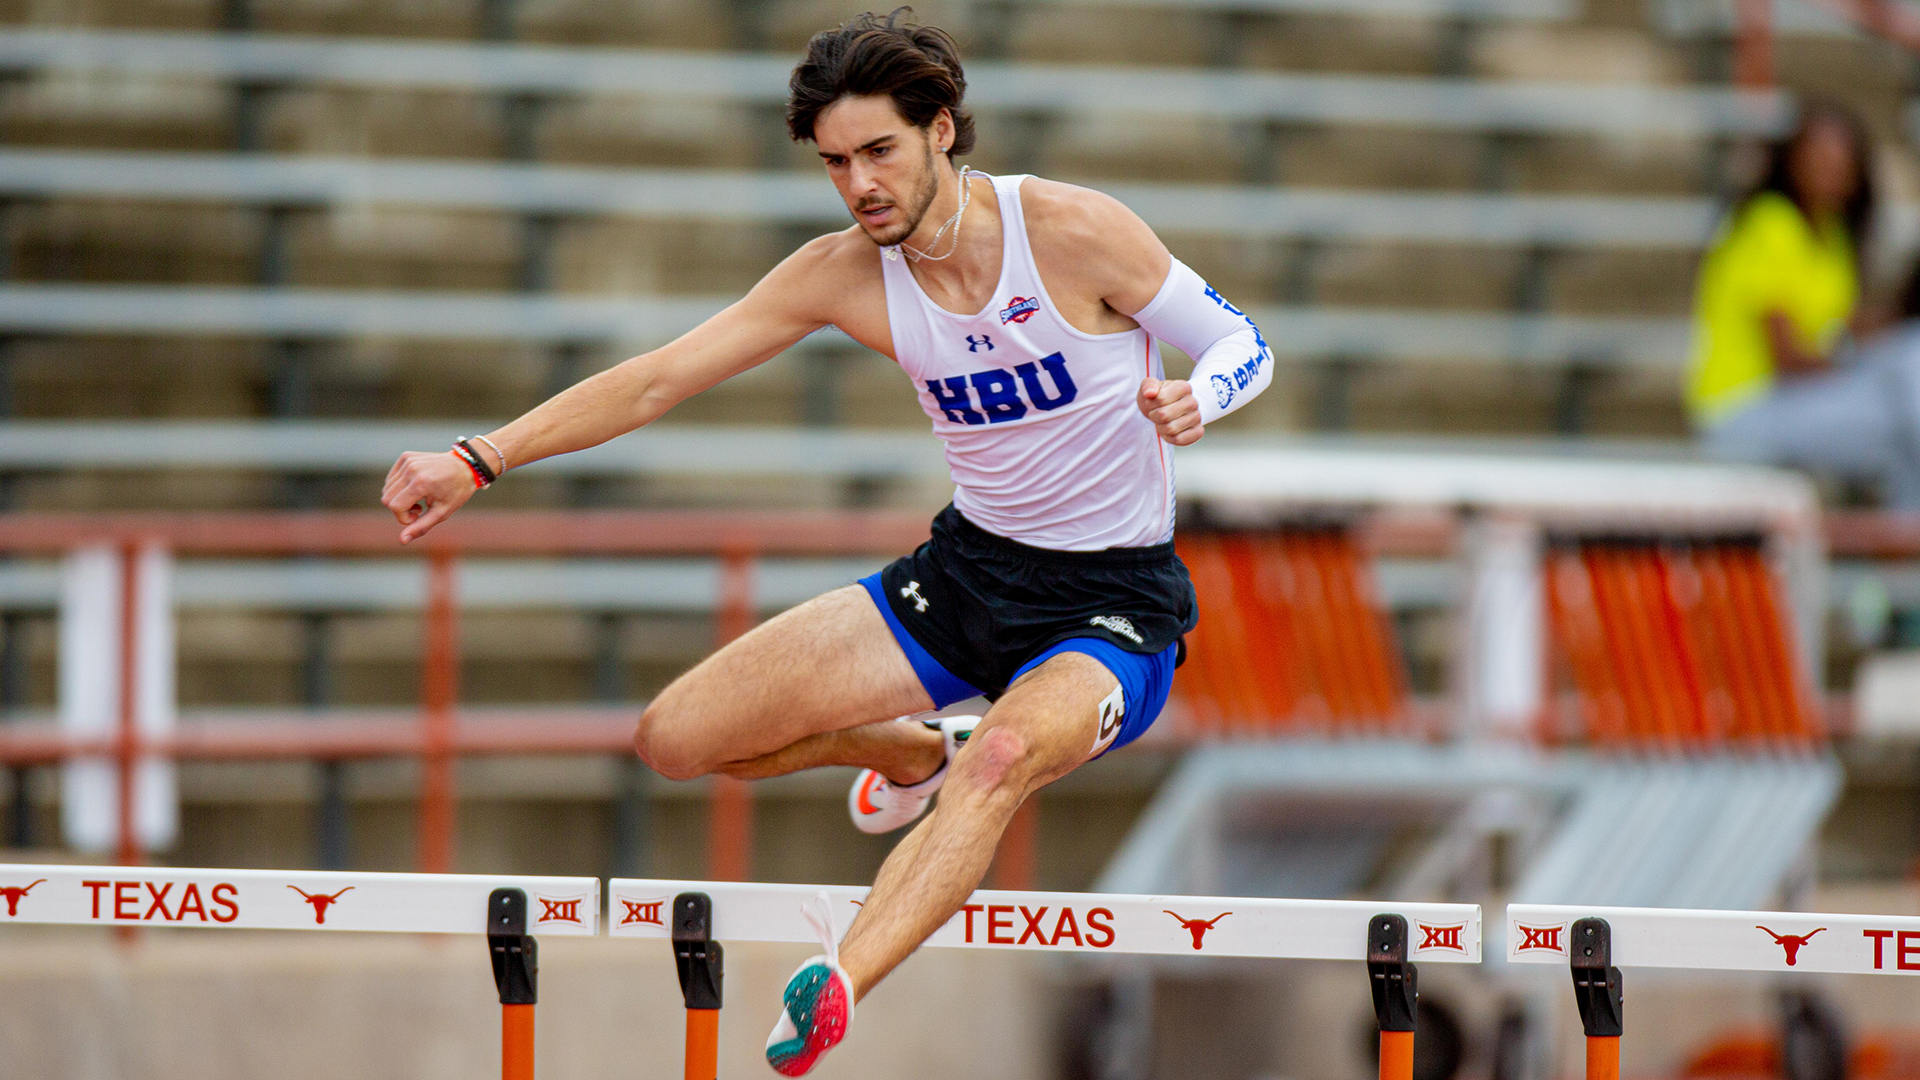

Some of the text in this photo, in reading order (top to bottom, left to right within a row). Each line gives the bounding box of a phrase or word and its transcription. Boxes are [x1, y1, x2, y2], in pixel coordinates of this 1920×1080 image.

[926, 351, 1079, 425] HBU
[82, 880, 239, 923] TEXAS
[538, 898, 582, 923] XII
[622, 899, 665, 926] XII
[961, 904, 1115, 948] TEXAS
[1419, 923, 1463, 951] XII
[1518, 925, 1564, 952] XII
